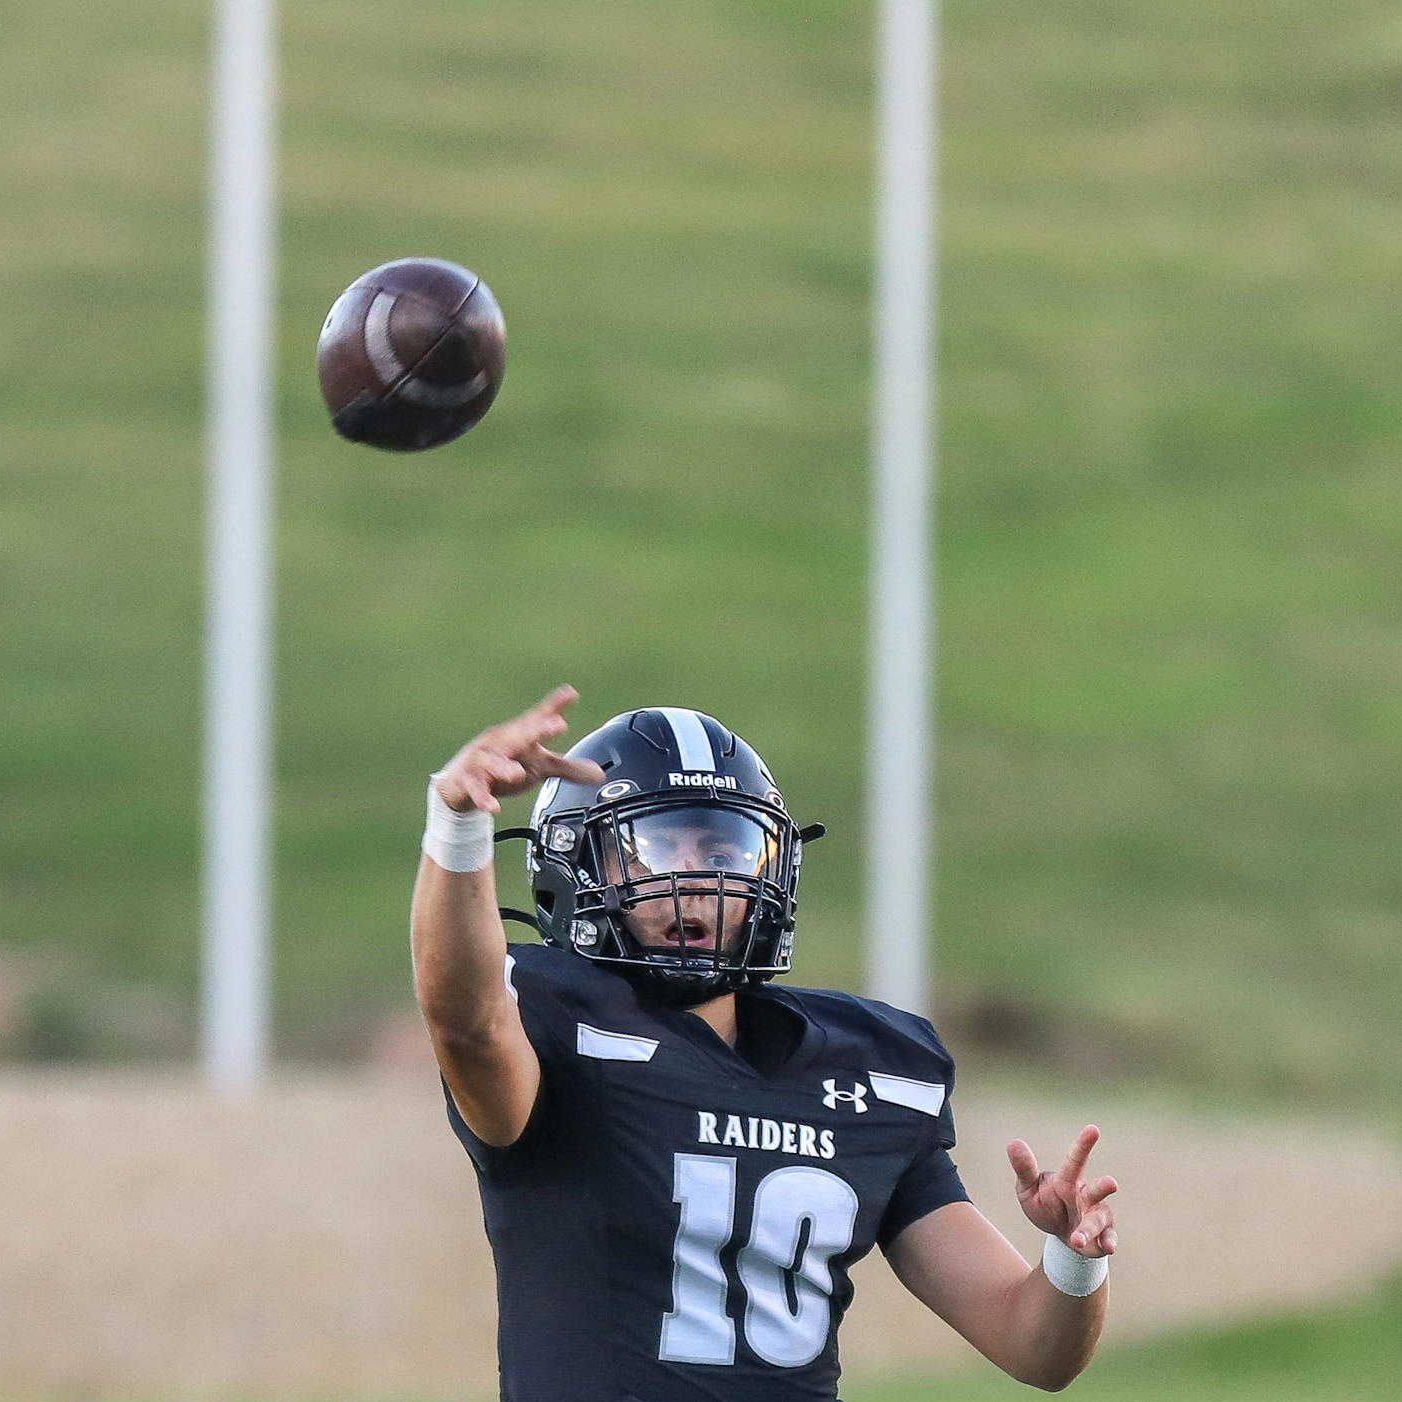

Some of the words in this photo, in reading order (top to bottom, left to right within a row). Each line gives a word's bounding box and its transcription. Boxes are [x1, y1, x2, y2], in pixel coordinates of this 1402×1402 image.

[668, 772, 738, 790] Riddell
[697, 1110, 837, 1160] RAIDERS
[658, 1151, 859, 1369] 10
